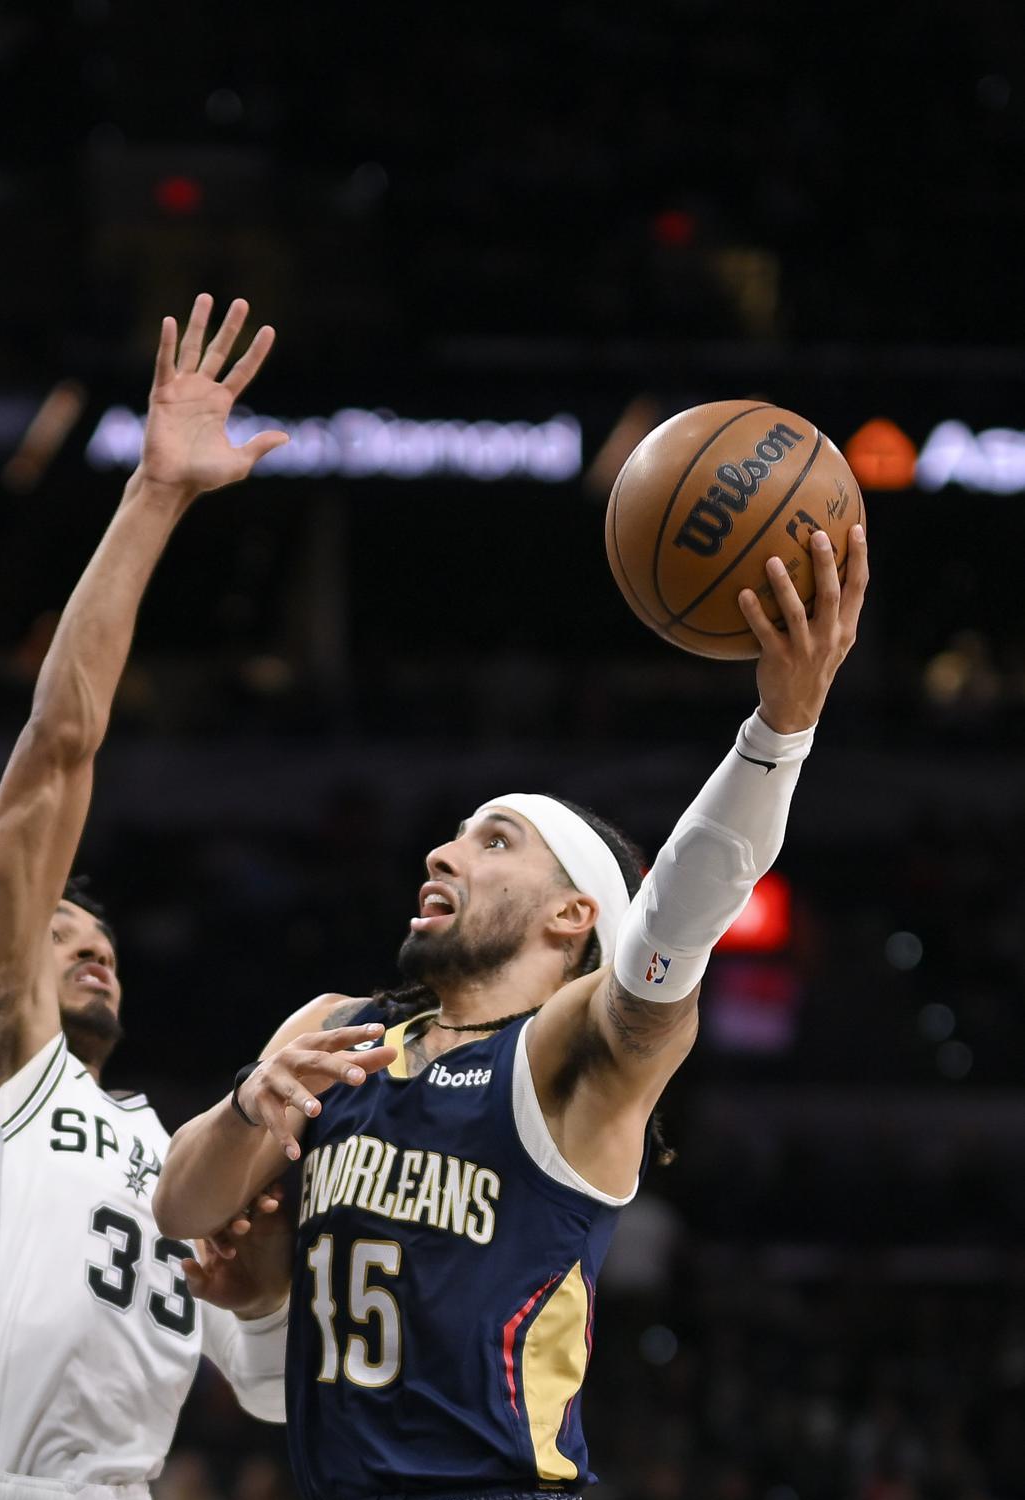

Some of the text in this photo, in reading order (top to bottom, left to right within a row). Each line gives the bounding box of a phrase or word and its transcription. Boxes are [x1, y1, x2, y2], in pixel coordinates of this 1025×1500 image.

[673, 422, 805, 557] Wilson
[428, 1063, 492, 1087] ibotta
[85, 1200, 197, 1342] 33
[307, 1234, 403, 1388] 15
